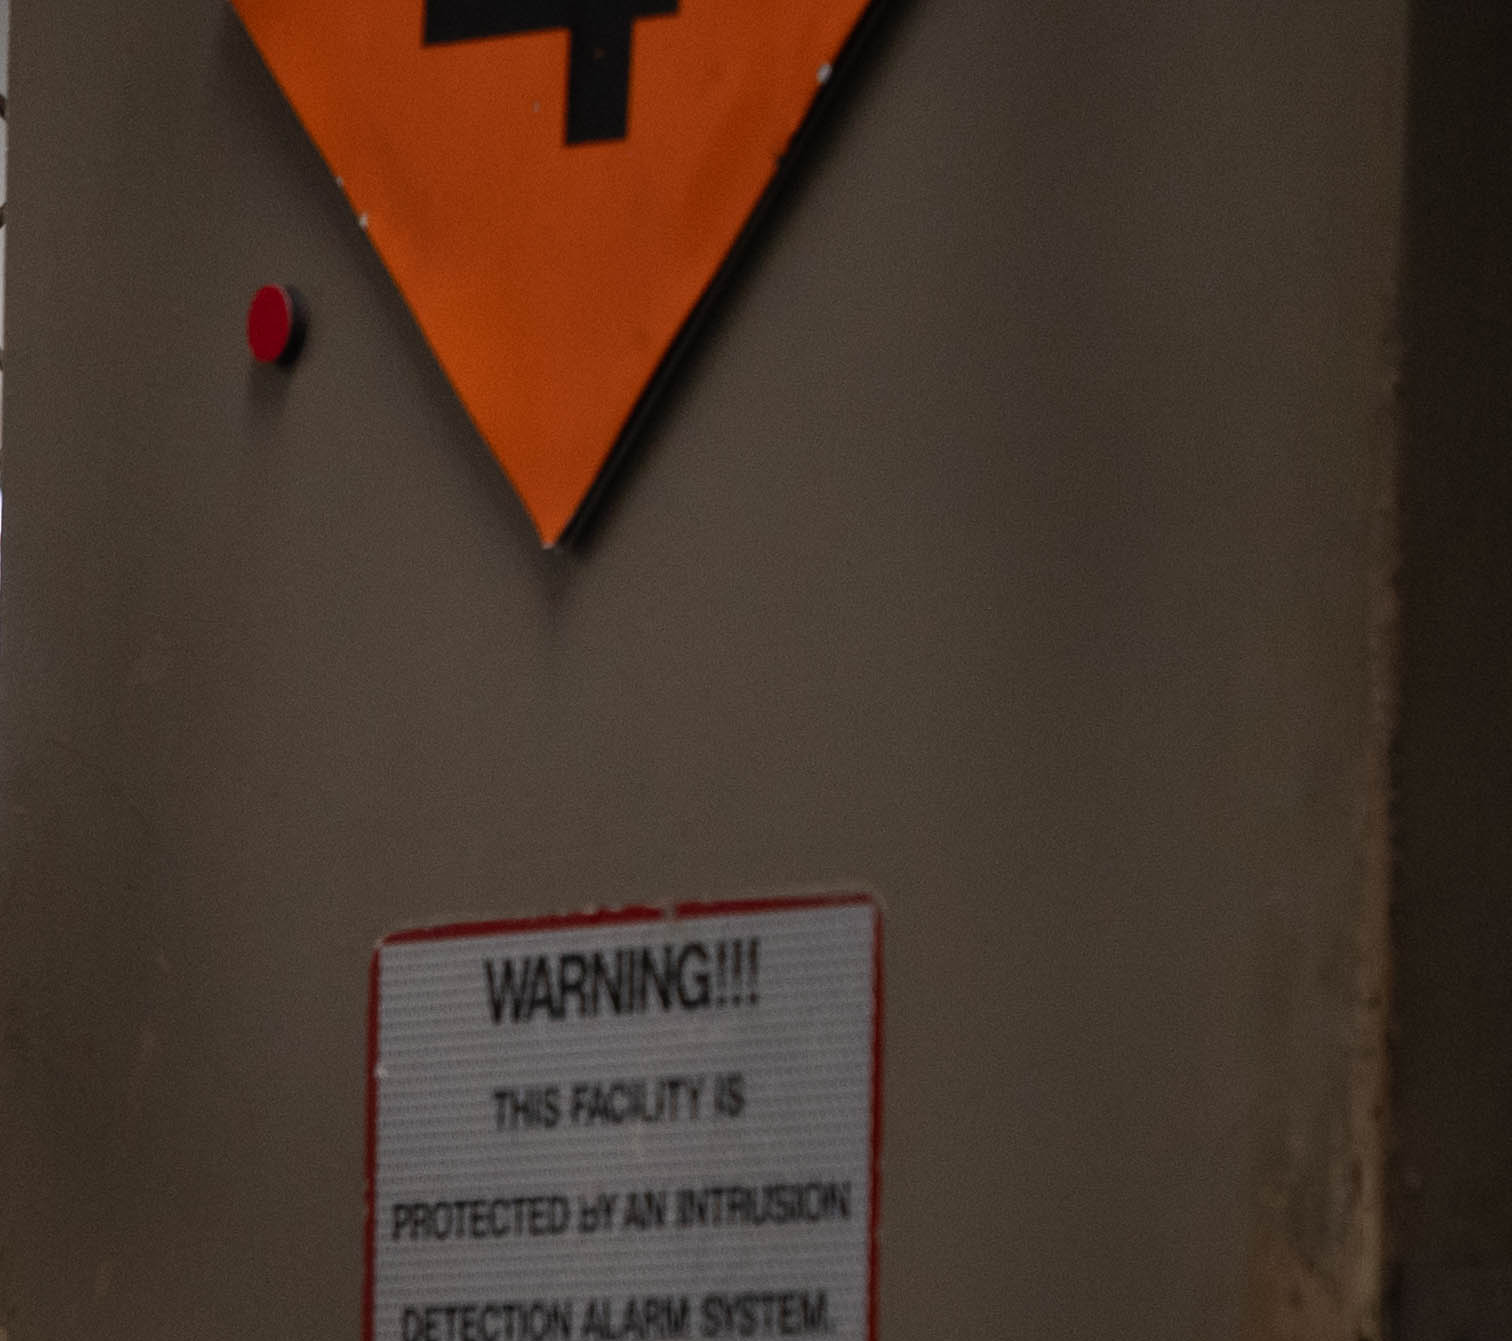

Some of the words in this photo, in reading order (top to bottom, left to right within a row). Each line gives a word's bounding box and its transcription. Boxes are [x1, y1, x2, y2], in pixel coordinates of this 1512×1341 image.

[485, 938, 761, 1023] WARNING!!!
[494, 1088, 561, 1130] THIS
[571, 1076, 704, 1127] FACILITY
[714, 1073, 745, 1118] IS
[391, 1197, 565, 1241] PROTECTED
[625, 1192, 663, 1231] AN
[677, 1182, 851, 1228] INTRUSION
[582, 1297, 690, 1341] ALARM
